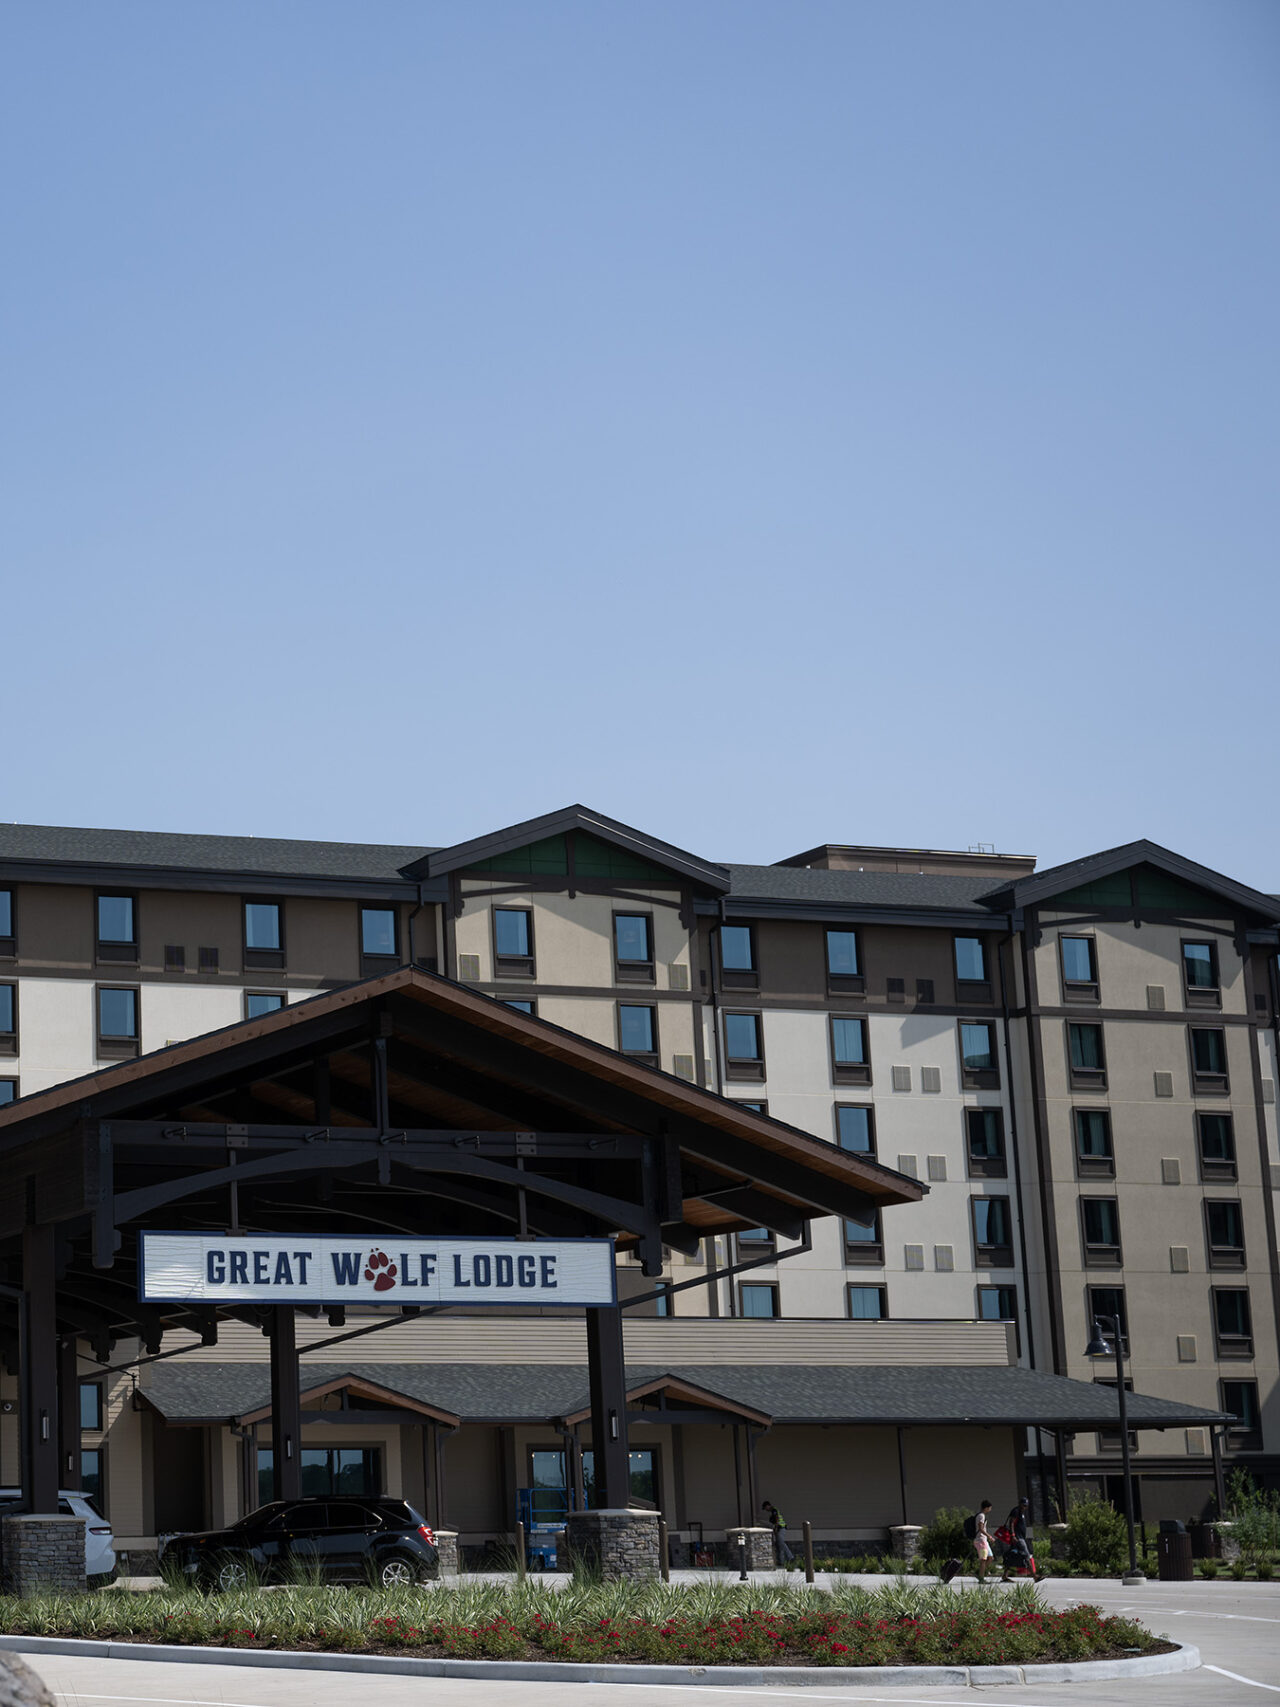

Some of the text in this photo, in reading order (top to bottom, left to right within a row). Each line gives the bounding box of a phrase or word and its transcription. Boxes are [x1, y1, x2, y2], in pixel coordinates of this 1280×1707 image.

[207, 1249, 558, 1291] GREAT WLF LODGE
